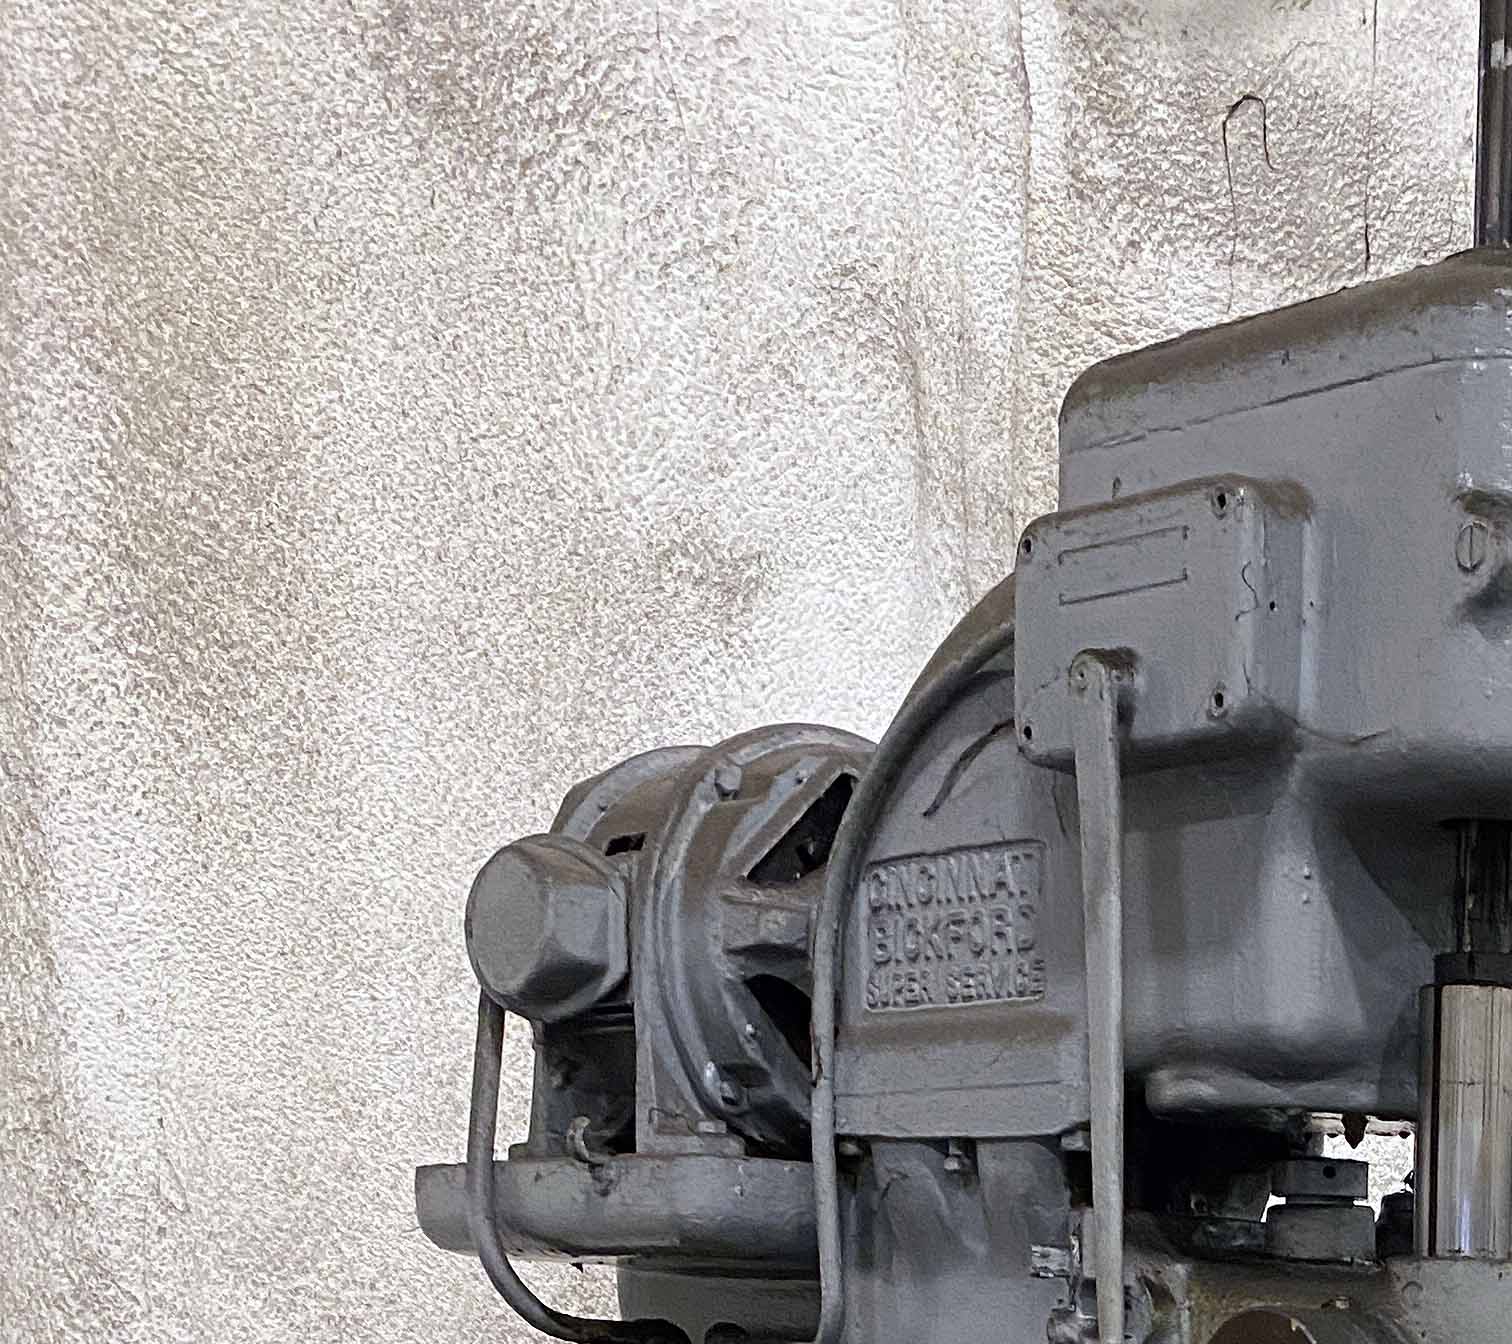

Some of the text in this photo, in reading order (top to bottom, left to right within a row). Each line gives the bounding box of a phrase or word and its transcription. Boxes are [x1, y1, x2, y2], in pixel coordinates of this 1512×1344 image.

[871, 903, 1037, 964] BICKFORD
[865, 957, 1046, 1009] SUPER SERVICE
